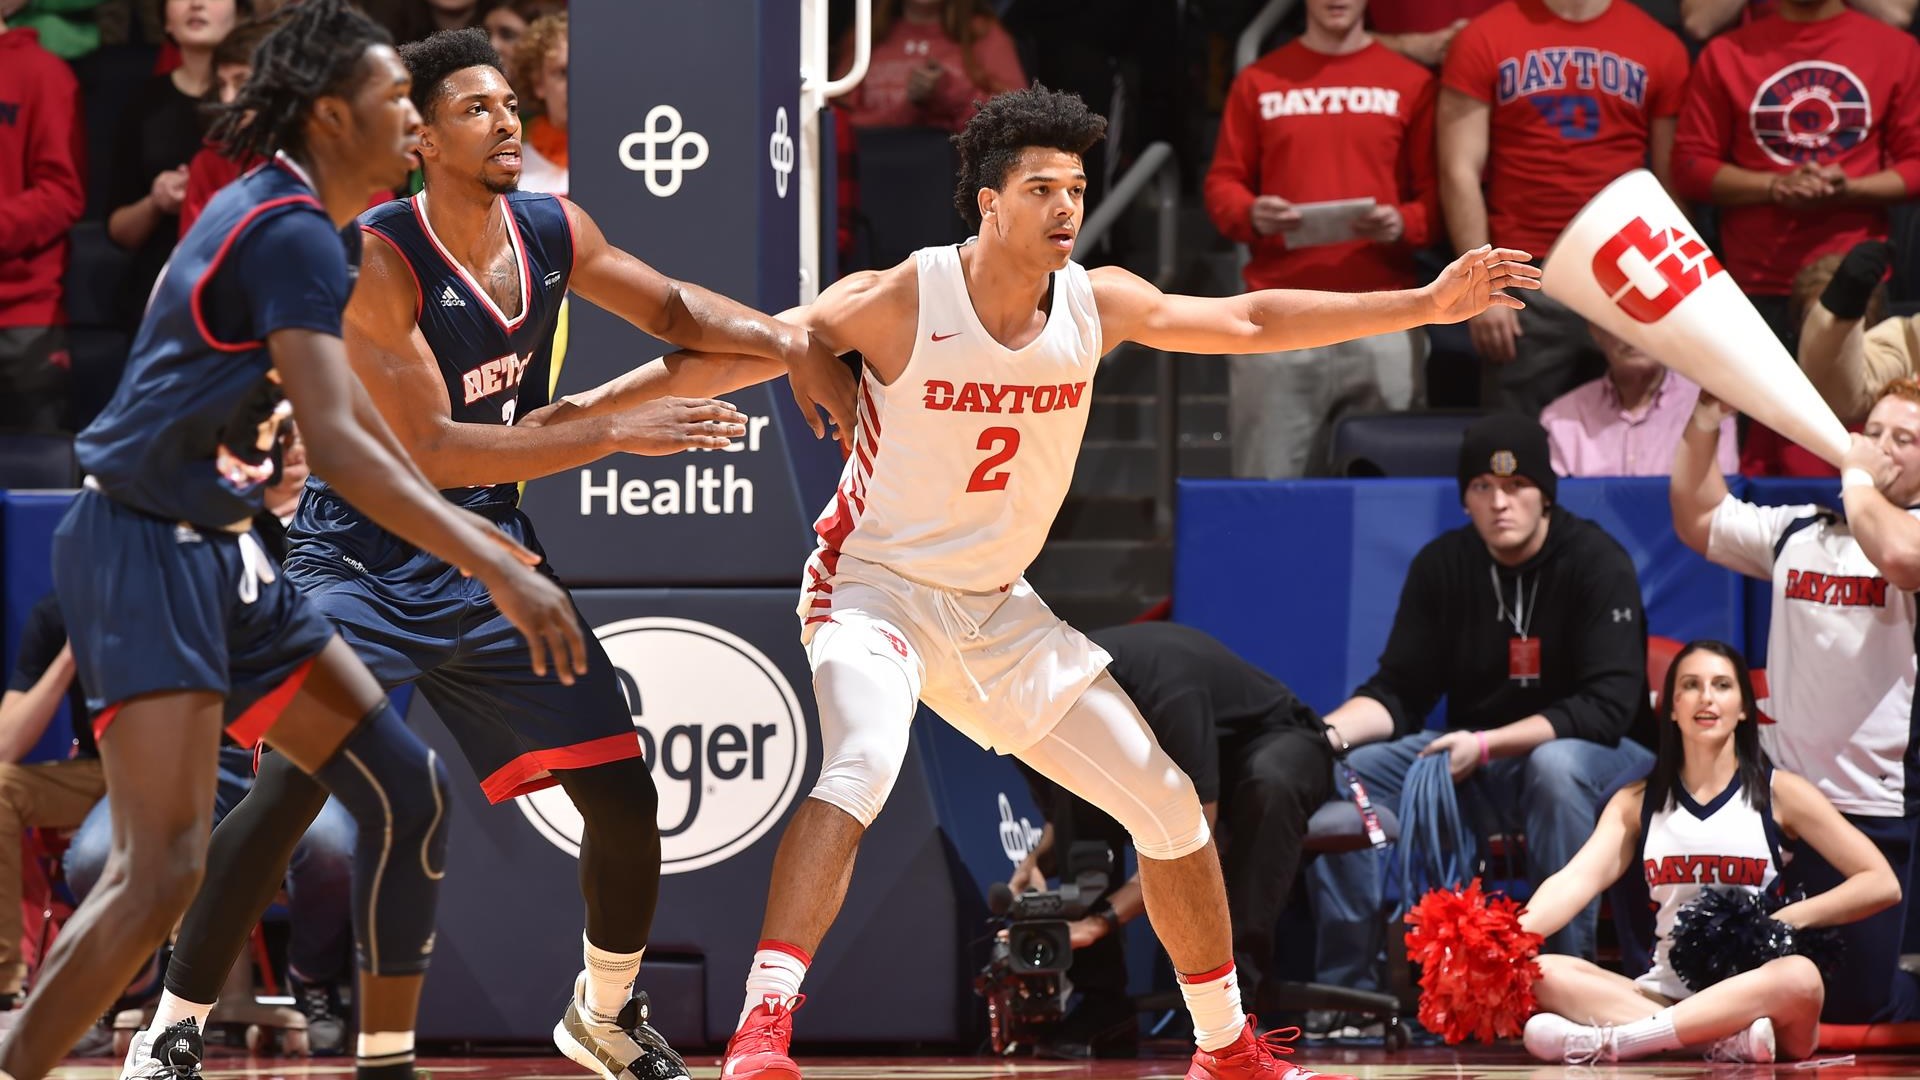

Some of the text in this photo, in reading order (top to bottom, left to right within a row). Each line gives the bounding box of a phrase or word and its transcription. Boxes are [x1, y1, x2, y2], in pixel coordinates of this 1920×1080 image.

[1497, 46, 1649, 107] DAYTON
[1258, 86, 1400, 120] DAYTON
[440, 299, 466, 307] adidas
[922, 379, 1087, 414] DAYTON
[965, 426, 1021, 493] 2
[580, 464, 754, 515] Health
[1785, 569, 1888, 608] DAYTON
[1644, 854, 1768, 888] DAYTON
